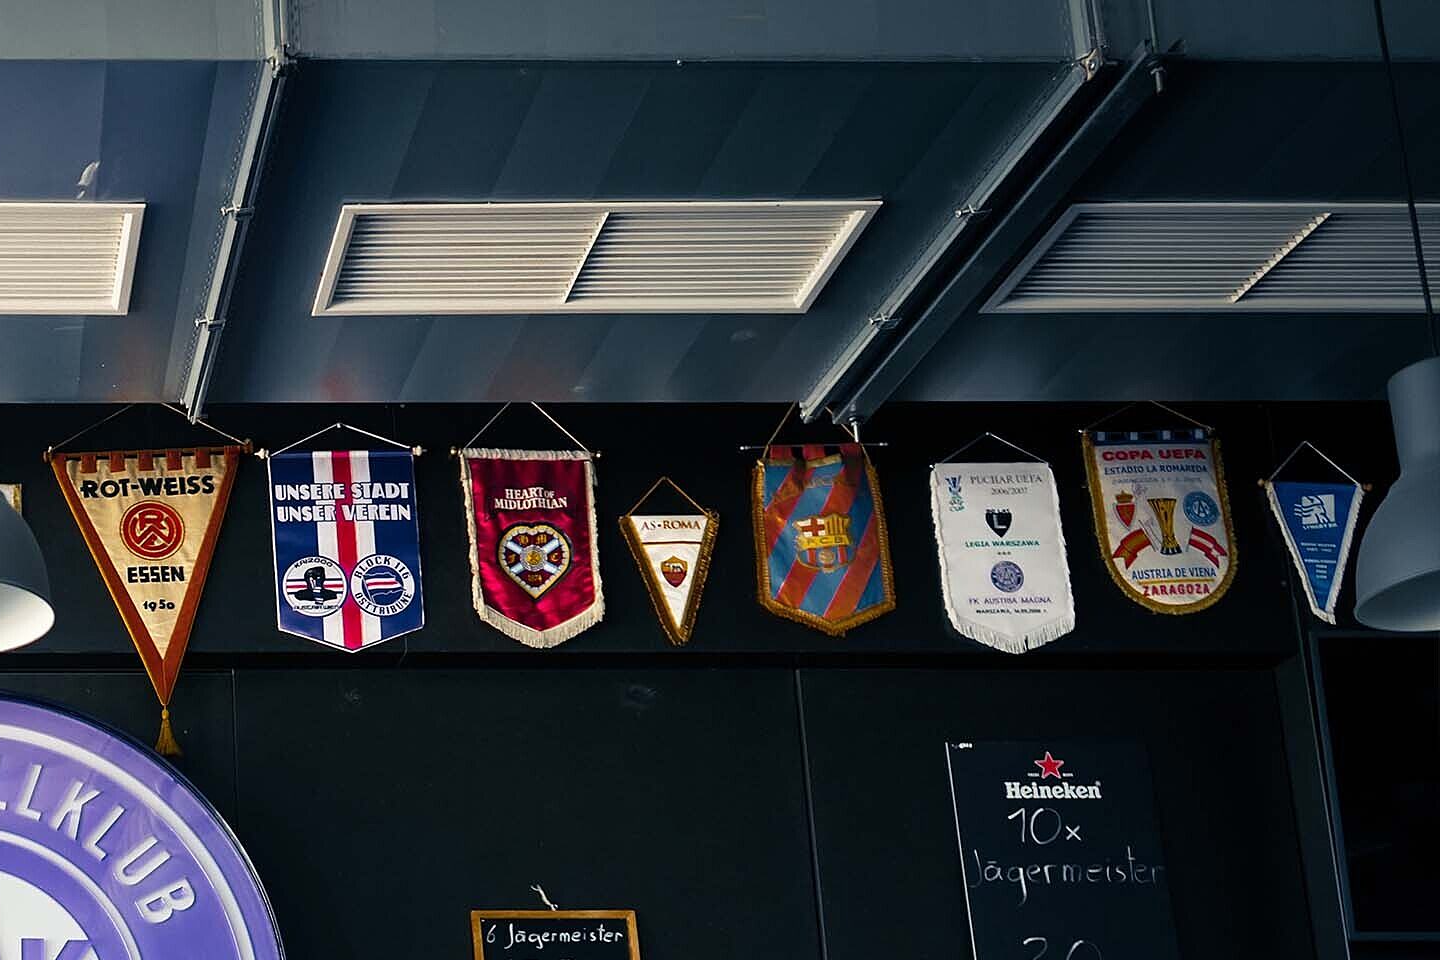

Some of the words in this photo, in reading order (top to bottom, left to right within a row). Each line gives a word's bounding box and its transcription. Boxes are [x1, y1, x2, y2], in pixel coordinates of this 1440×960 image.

[1102, 449, 1153, 462] COPA
[1160, 449, 1207, 461] UEFA
[1104, 464, 1145, 476] ESTADIO
[1147, 464, 1158, 474] LA
[80, 475, 215, 499] ROT-WEISS
[274, 483, 346, 501] UNSERE
[350, 482, 410, 501] STADT
[504, 487, 545, 501] HEART
[543, 490, 555, 499] OF
[494, 497, 568, 511] MIDLOTHIAN
[276, 505, 337, 522] UNSER
[342, 503, 412, 521] VEREIN
[126, 566, 185, 584] ESSEN
[354, 556, 392, 579] BLOCK
[1131, 568, 1173, 580] AUSTRIA
[1174, 568, 1189, 578] DE
[1190, 567, 1217, 578] VIENA
[1142, 583, 1211, 598] ZARAGOZA
[143, 599, 176, 612] 1950
[1004, 780, 1104, 800] Heineken
[486, 924, 498, 944] 6
